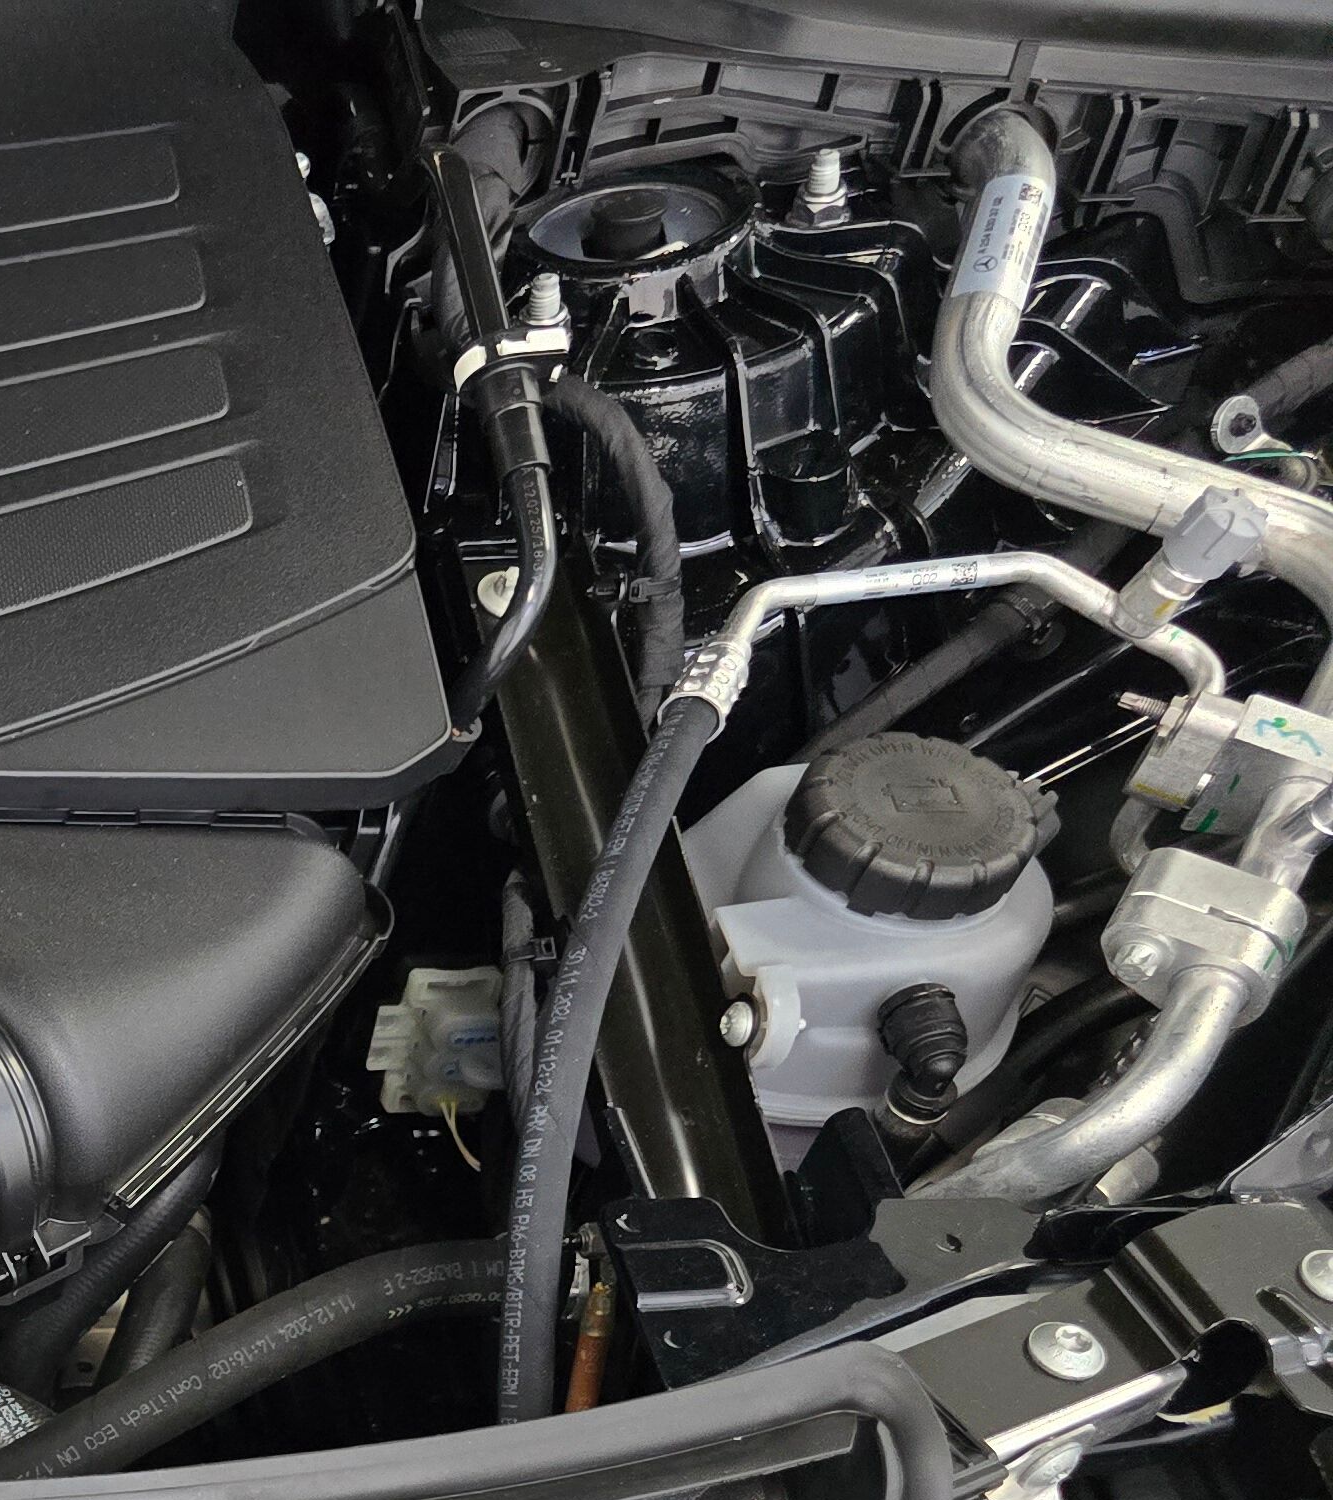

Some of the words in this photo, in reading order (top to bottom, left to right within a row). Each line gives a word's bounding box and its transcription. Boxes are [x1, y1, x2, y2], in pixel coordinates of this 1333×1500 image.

[535, 1029, 563, 1096] 01:12:24
[208, 1333, 277, 1380] 14:16:02
[120, 1375, 203, 1428] ContiTech
[56, 1444, 81, 1469] DN
[86, 1422, 118, 1451] ECO
